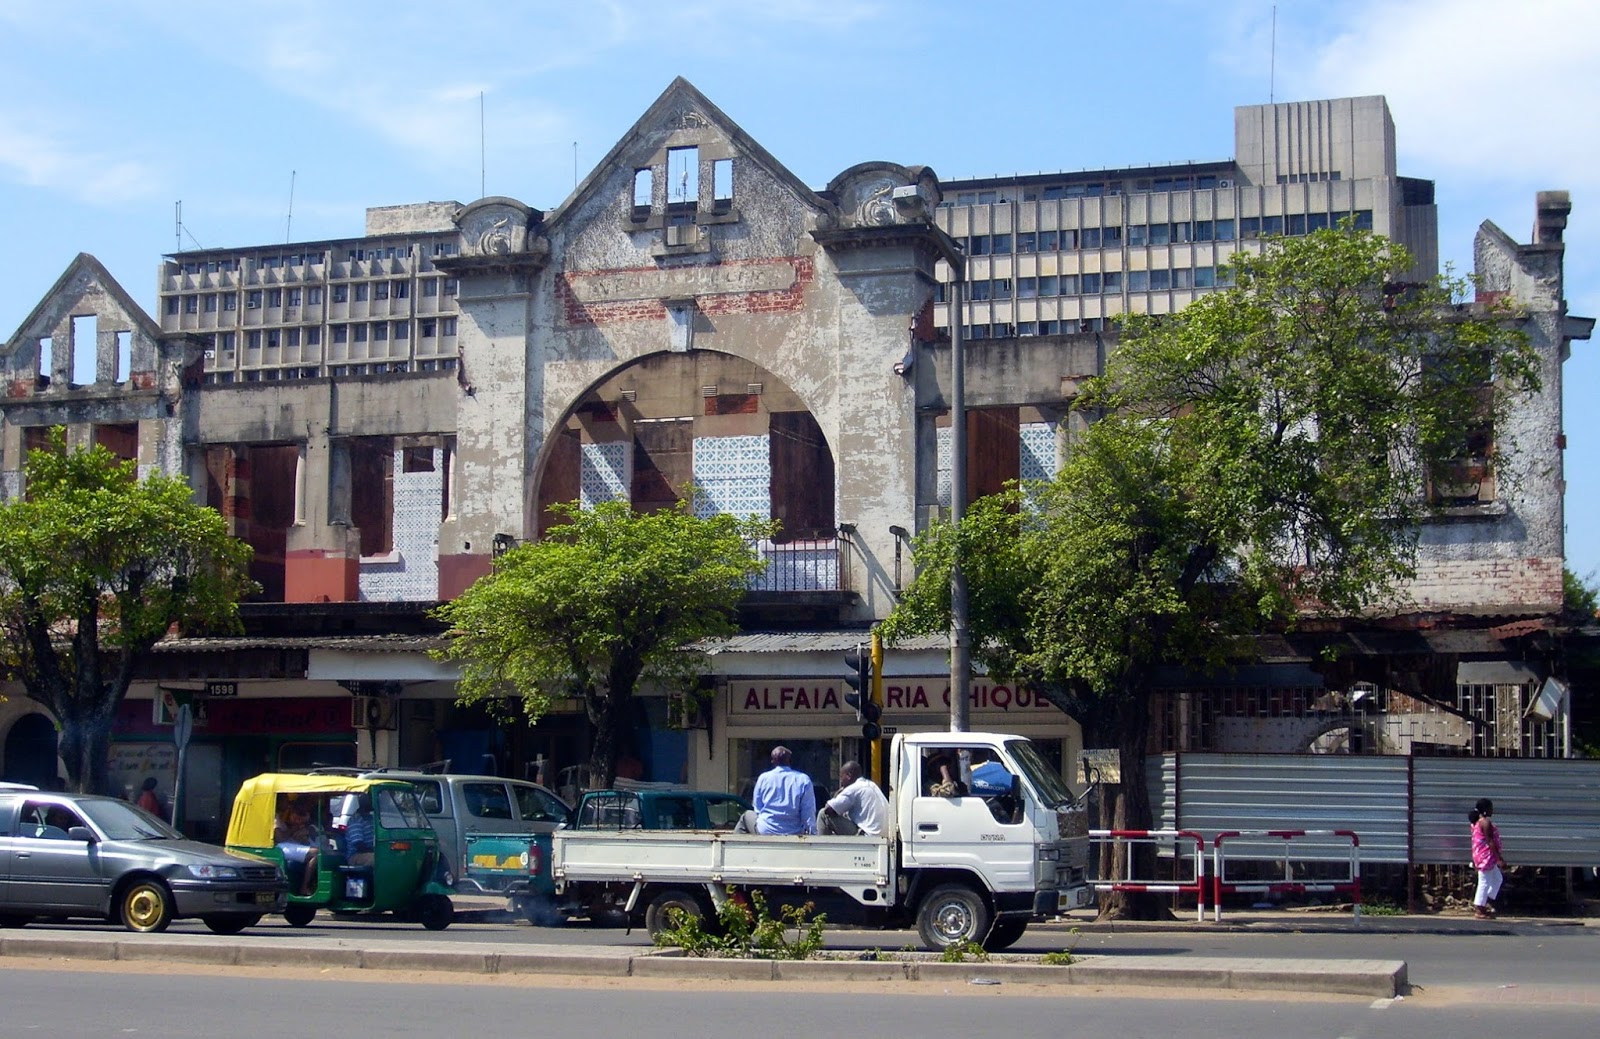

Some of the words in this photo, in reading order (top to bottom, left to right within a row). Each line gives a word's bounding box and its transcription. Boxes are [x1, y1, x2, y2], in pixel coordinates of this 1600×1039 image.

[210, 684, 234, 695] 1598
[744, 686, 929, 708] ALFAIARIA
[980, 833, 1006, 842] DYNA
